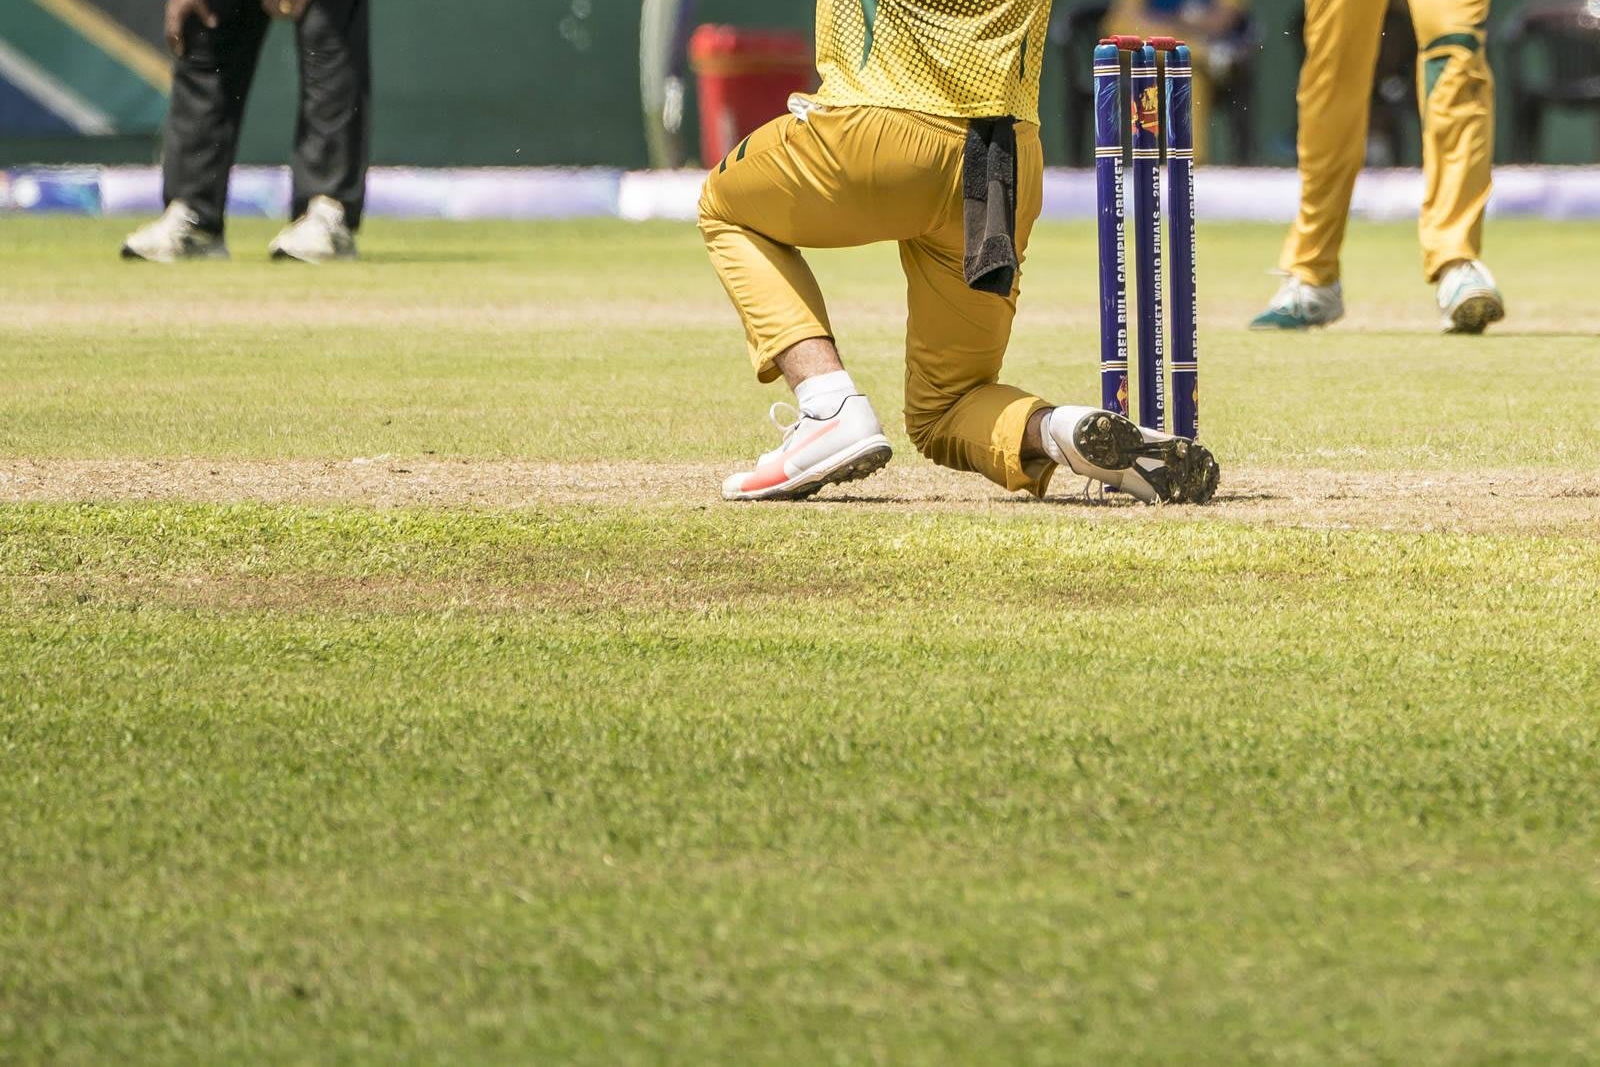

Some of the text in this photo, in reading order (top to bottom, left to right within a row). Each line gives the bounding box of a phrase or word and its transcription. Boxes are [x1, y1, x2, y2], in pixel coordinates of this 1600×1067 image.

[1114, 158, 1124, 217] CRICKET
[1152, 167, 1160, 198] 2017
[1153, 211, 1161, 254] FINALS
[1154, 258, 1162, 301] WORLD
[1117, 329, 1127, 358] RED
[1155, 304, 1163, 355] CRICKET
[1155, 359, 1164, 410] CAMPUS
